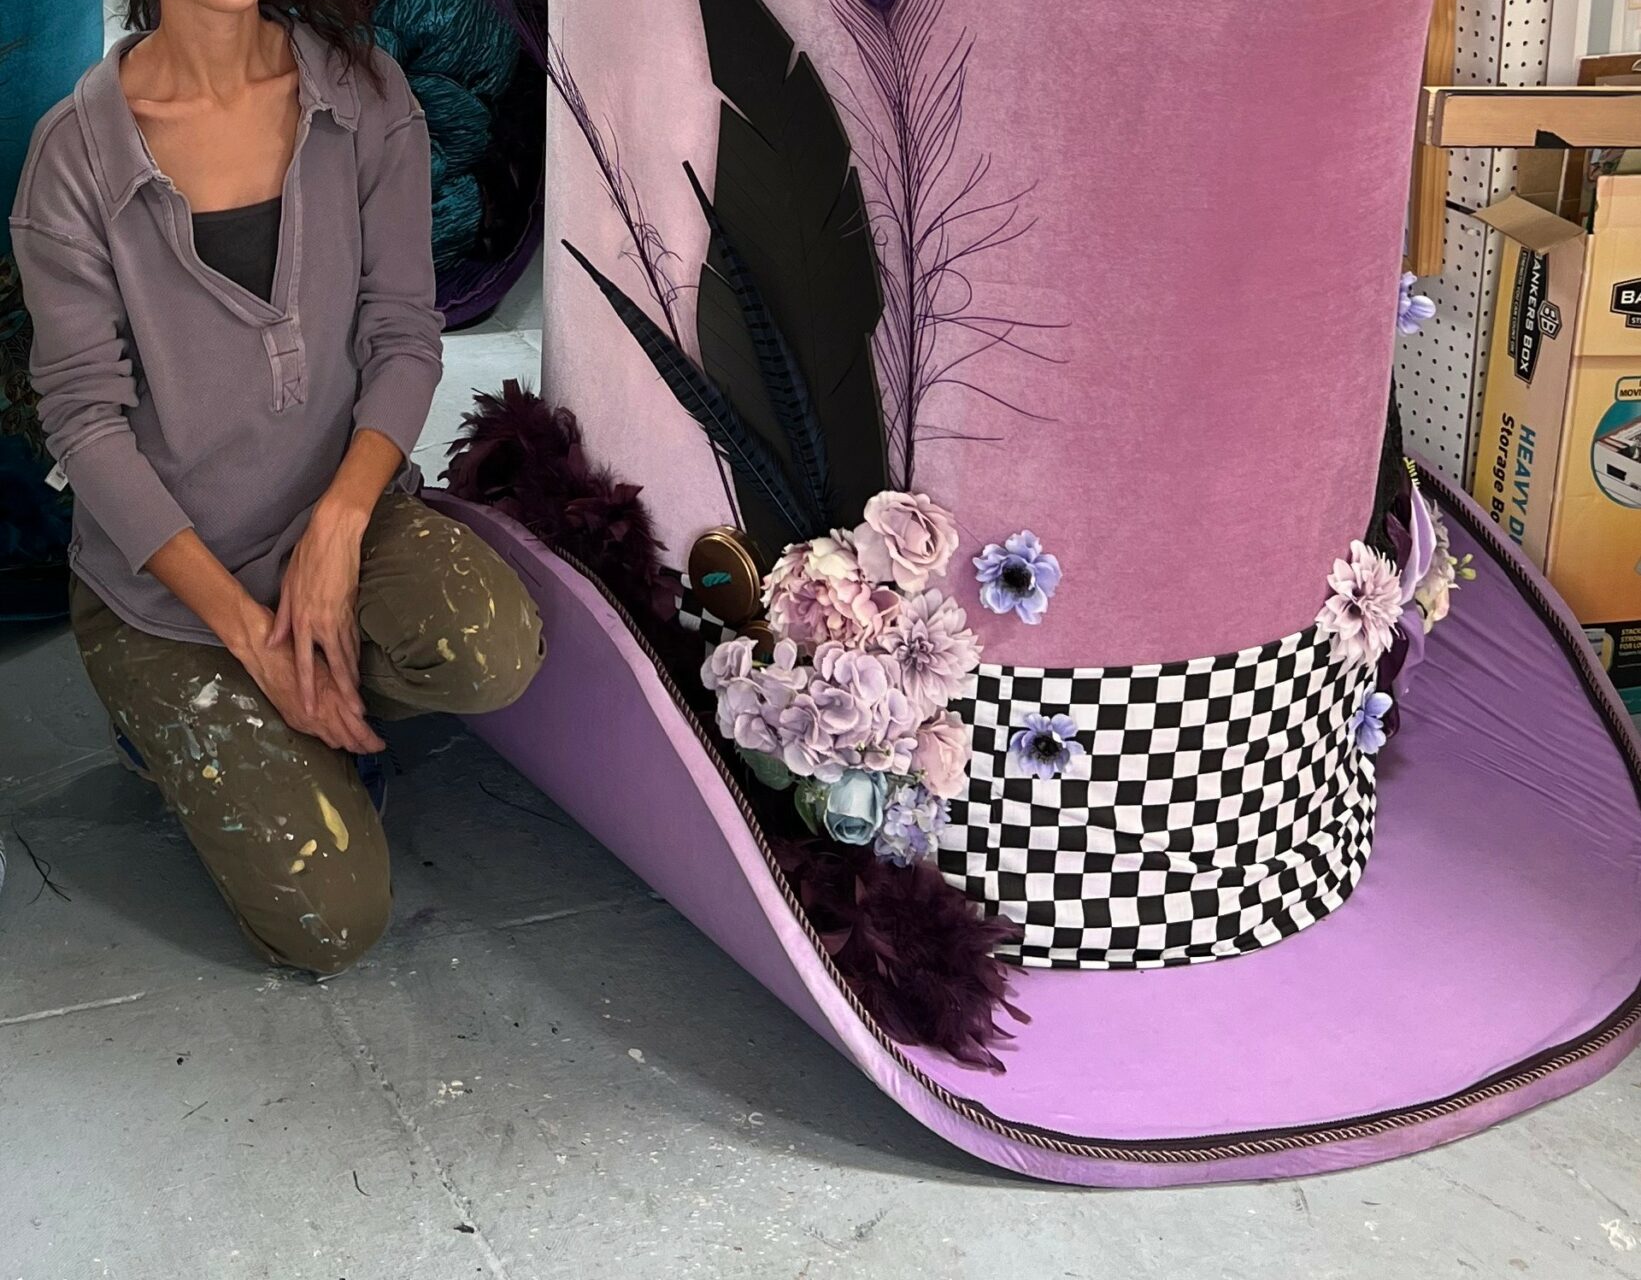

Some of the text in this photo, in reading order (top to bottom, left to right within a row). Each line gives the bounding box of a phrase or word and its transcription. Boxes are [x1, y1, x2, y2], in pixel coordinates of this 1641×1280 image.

[1520, 334, 1533, 372] BOX
[1493, 412, 1515, 493] Storage
[1511, 424, 1536, 515] HEAVY
